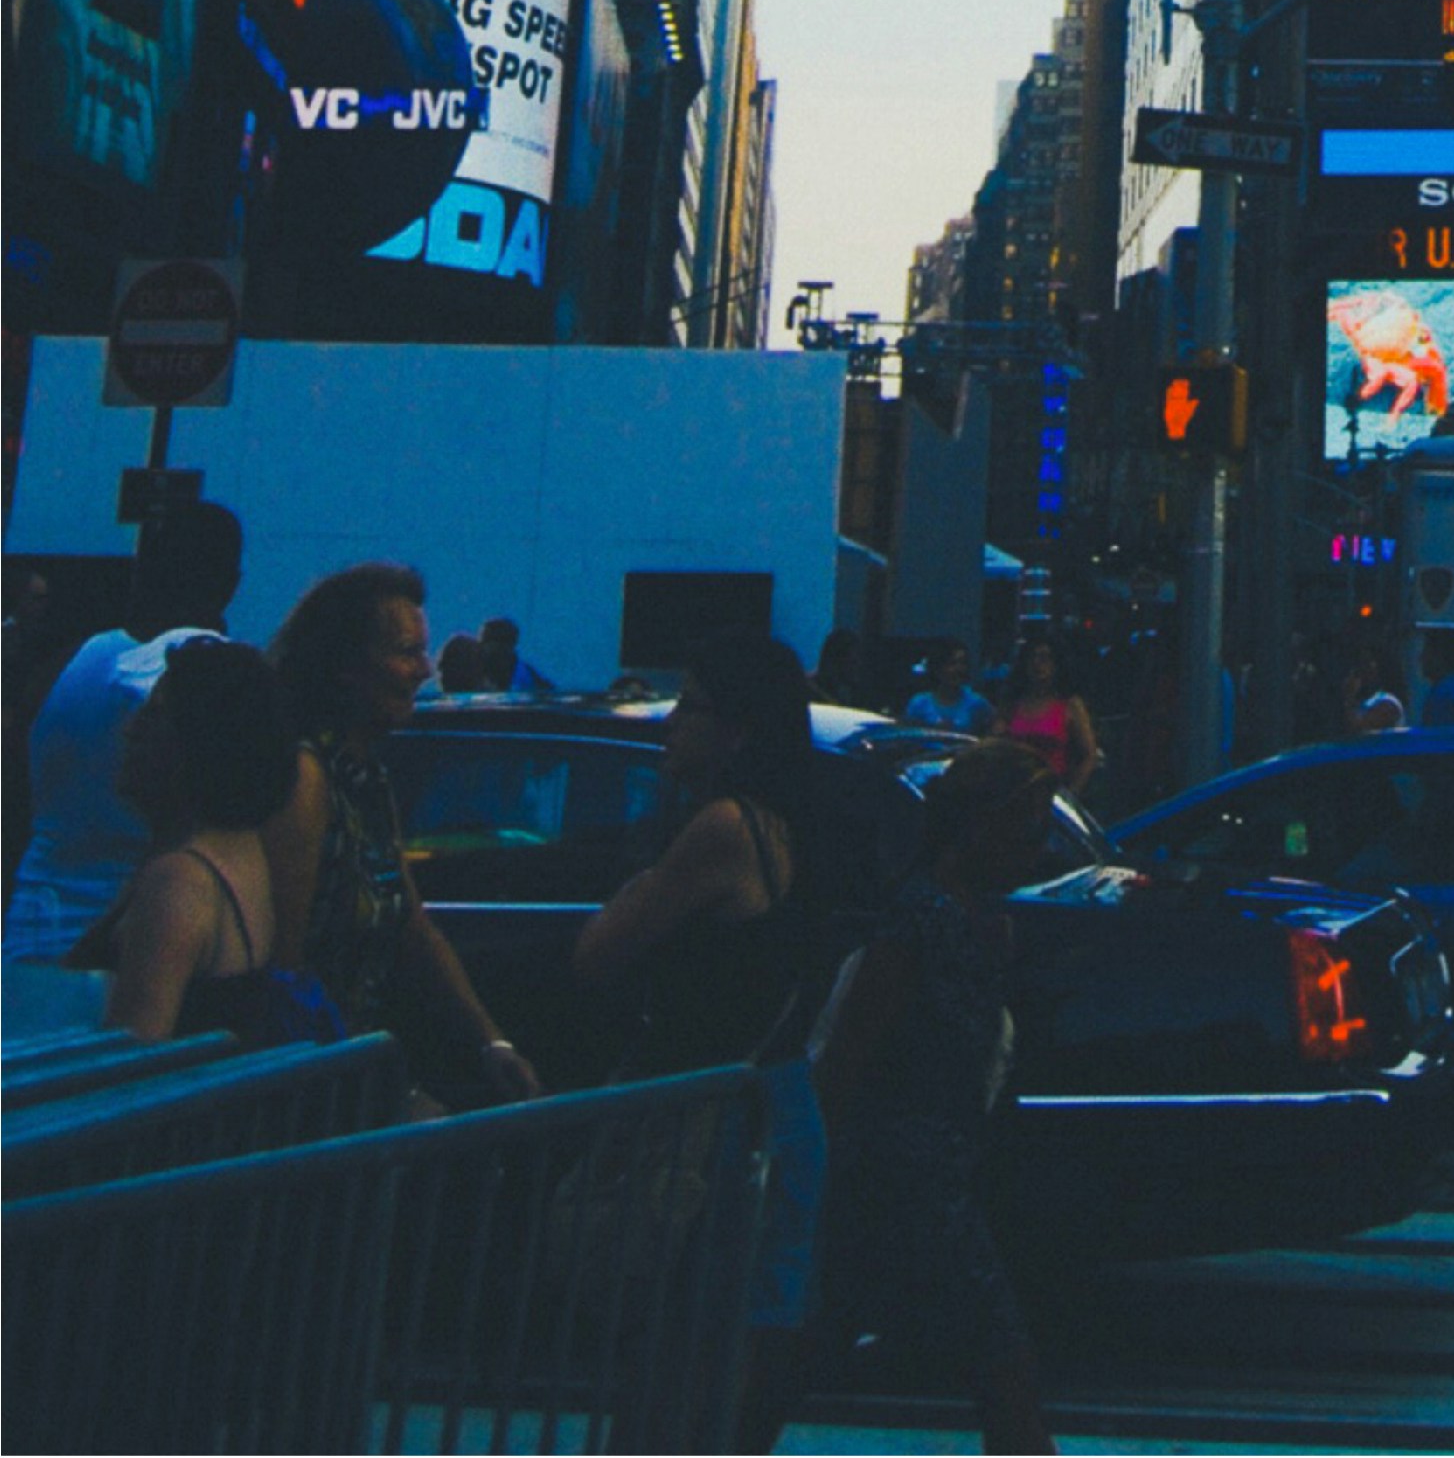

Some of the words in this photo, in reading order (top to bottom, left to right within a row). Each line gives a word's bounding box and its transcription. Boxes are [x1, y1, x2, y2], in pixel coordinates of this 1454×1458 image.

[472, 45, 553, 104] SPOT
[392, 88, 468, 130] JVC
[1162, 125, 1205, 152] ONE
[1231, 134, 1280, 162] WAY
